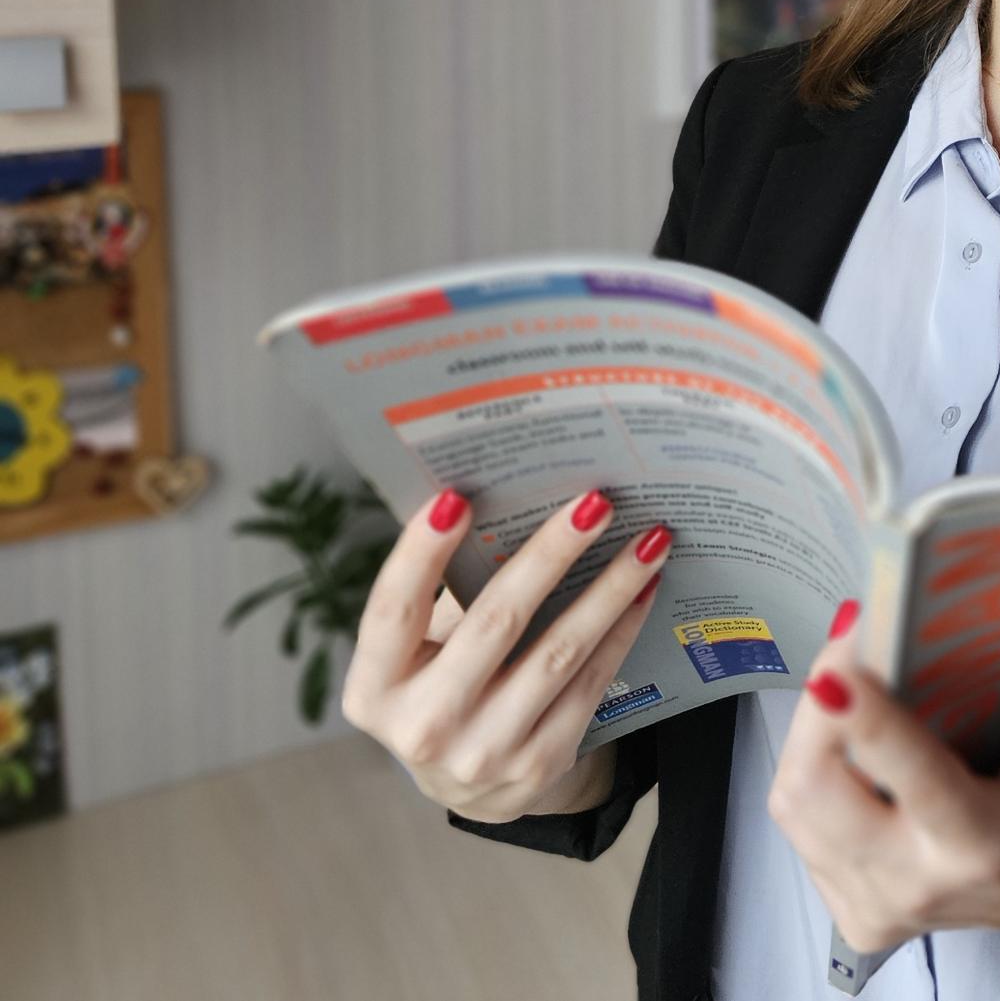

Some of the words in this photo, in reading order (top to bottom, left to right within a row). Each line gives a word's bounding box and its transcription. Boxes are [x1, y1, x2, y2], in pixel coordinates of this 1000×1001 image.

[642, 493, 711, 502] preparation
[690, 499, 712, 507] and
[696, 542, 727, 550] Exam
[728, 543, 777, 562] Strategies
[674, 593, 739, 605] Recommended
[698, 599, 736, 607] students
[671, 610, 691, 619] who
[723, 604, 754, 612] expand
[704, 609, 749, 618] vocabulary
[703, 620, 733, 628] Active
[733, 619, 761, 627] Study
[704, 624, 763, 634] Dictionary
[680, 624, 727, 680] LONGMAN
[597, 685, 652, 712] PEARSON
[602, 694, 657, 719] Longman
